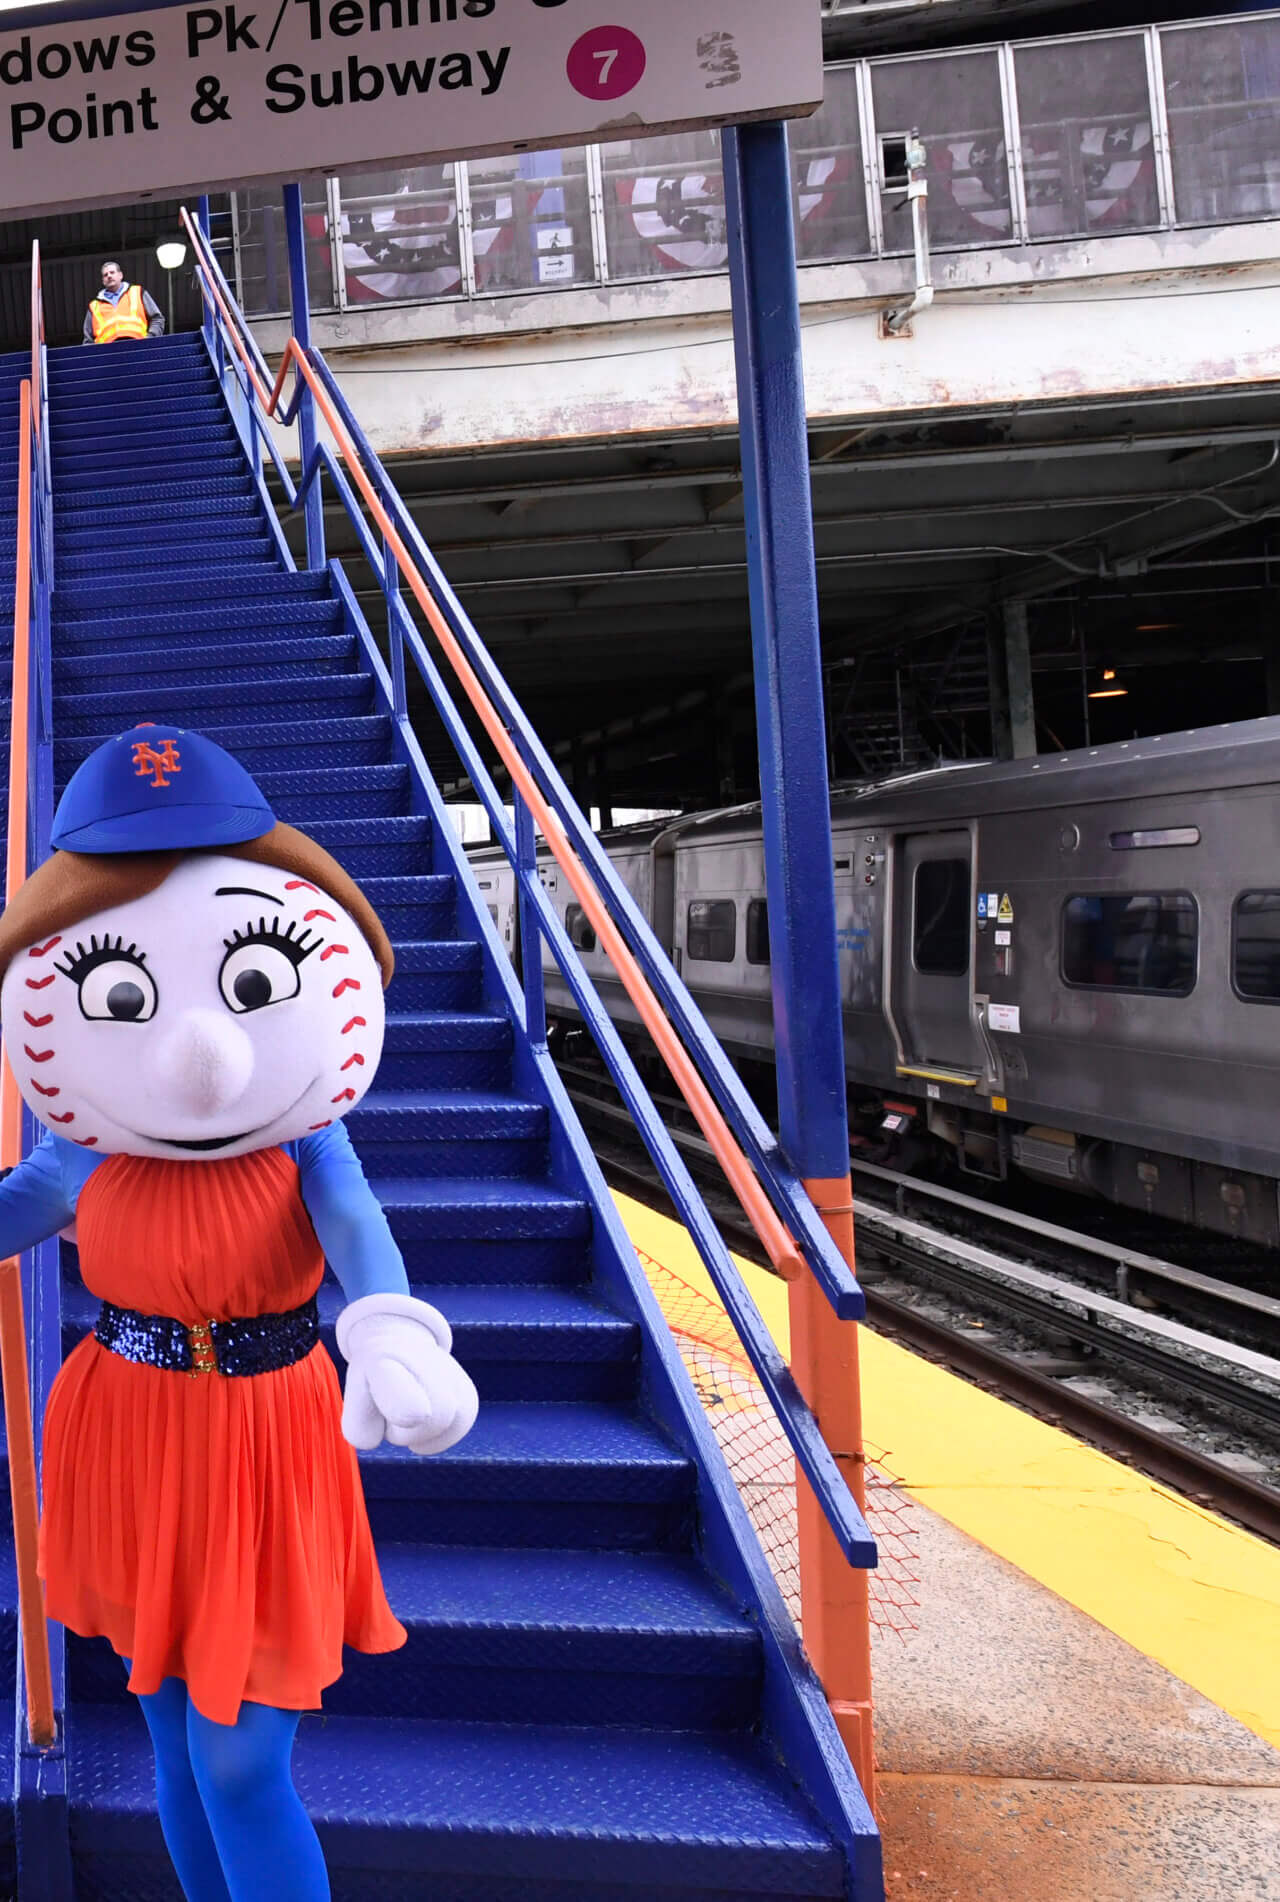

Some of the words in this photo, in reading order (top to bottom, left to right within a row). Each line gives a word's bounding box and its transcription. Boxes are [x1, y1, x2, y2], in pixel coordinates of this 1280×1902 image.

[592, 49, 619, 85] 7
[11, 85, 159, 150] Point
[192, 76, 233, 125] &
[265, 46, 511, 114] Subway
[131, 739, 181, 787] NY
